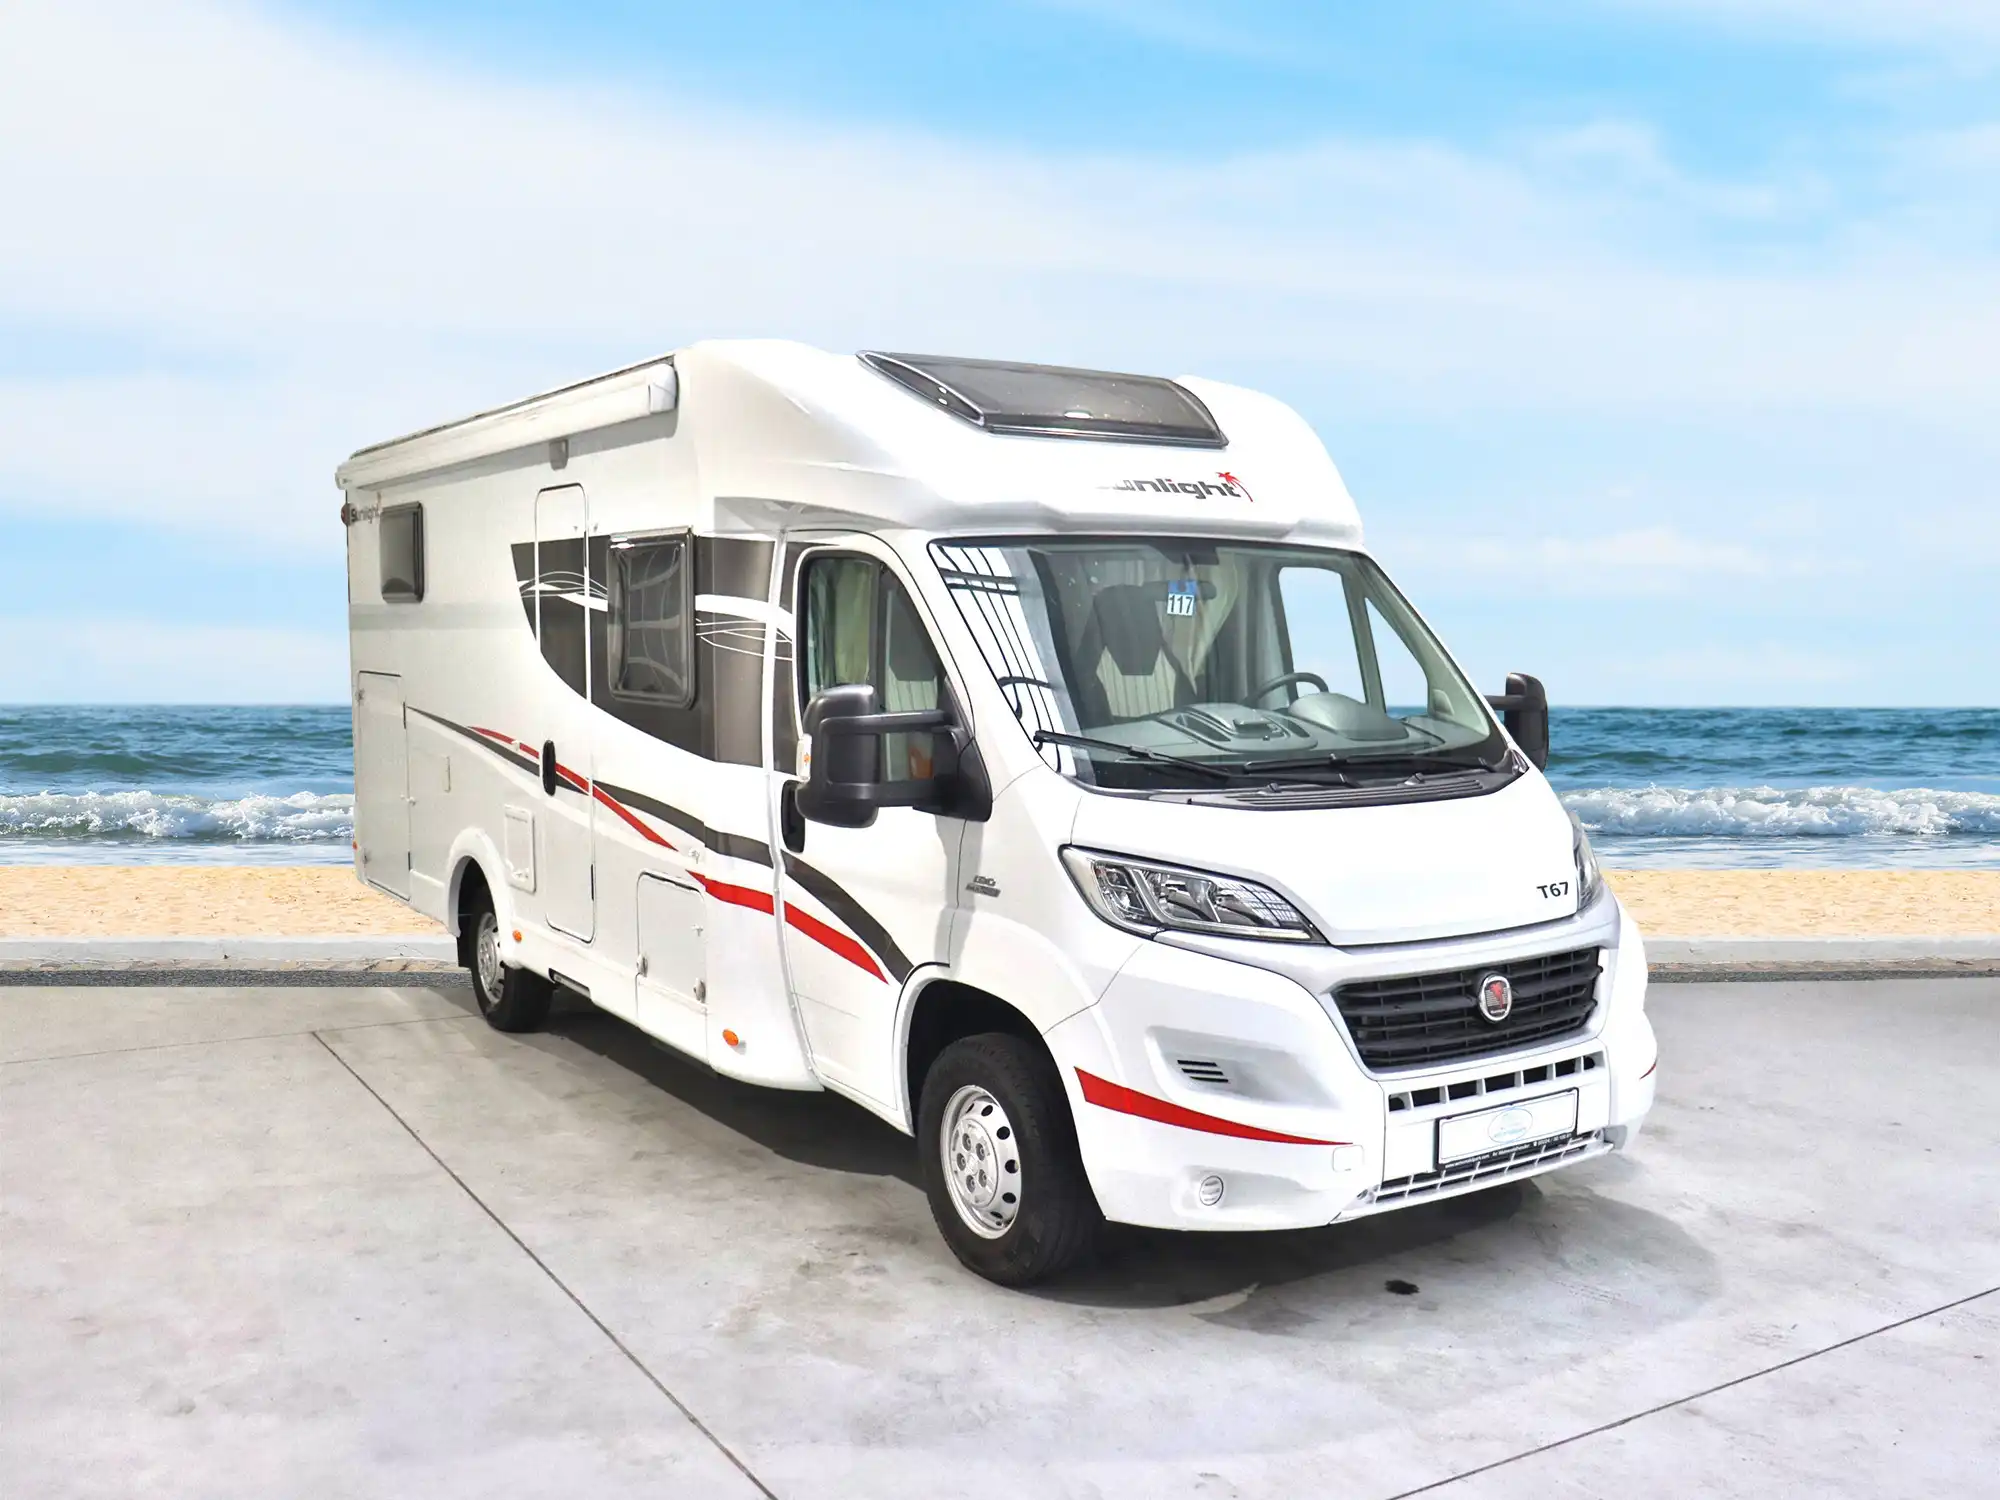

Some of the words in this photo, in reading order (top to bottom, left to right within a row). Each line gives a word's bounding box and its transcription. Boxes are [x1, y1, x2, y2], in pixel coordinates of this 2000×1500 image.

[1097, 478, 1241, 500] unlight
[1169, 595, 1193, 614] 117
[1536, 881, 1569, 899] T67
